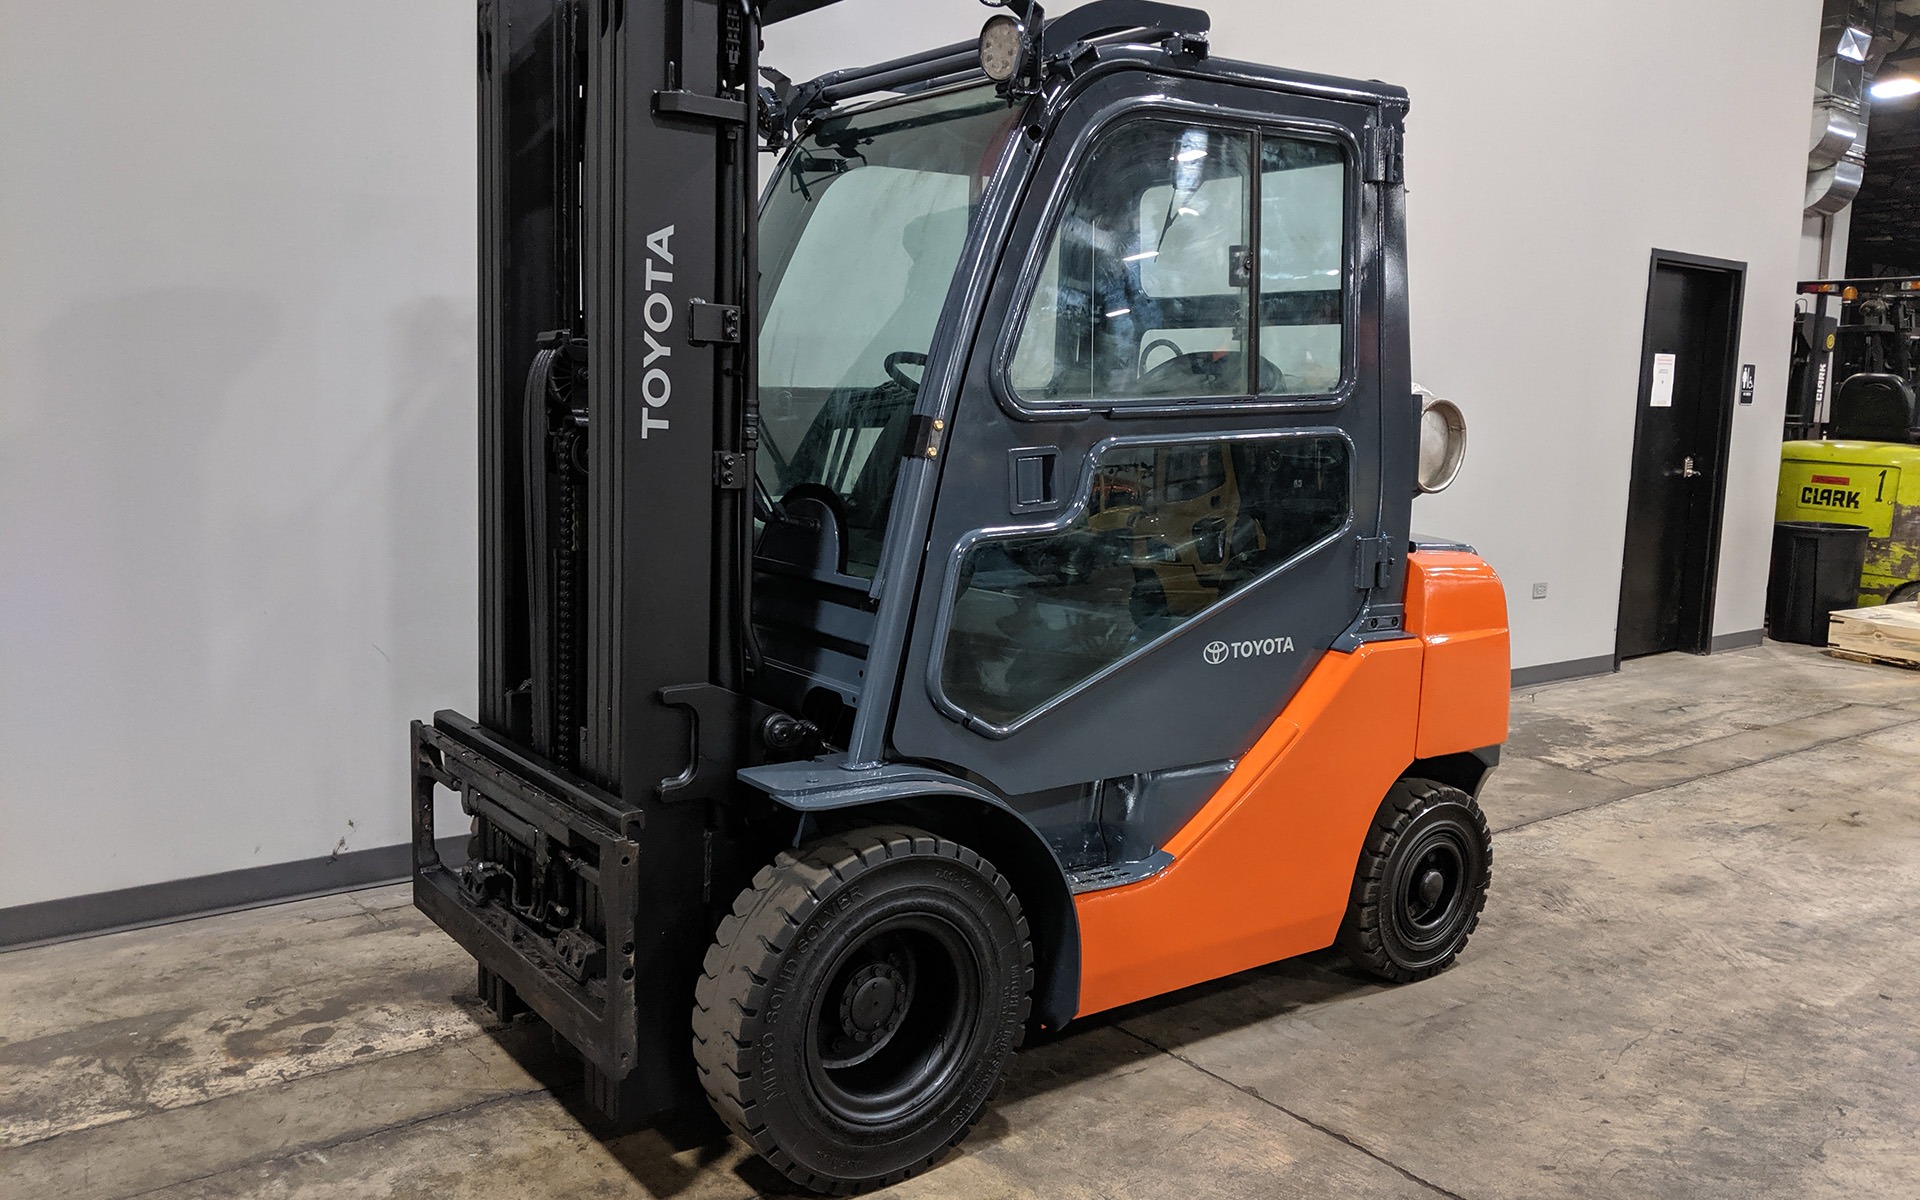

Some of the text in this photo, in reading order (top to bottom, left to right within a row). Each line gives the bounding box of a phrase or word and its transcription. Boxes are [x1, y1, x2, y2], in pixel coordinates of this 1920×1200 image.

[641, 224, 675, 440] TOYOTA
[1815, 363, 1827, 402] CLARK
[1801, 486, 1861, 509] CLARK
[1874, 469, 1888, 503] 1
[1230, 636, 1295, 659] TOYOTA
[765, 958, 798, 1024] SOLID
[797, 884, 864, 954] SOLVER
